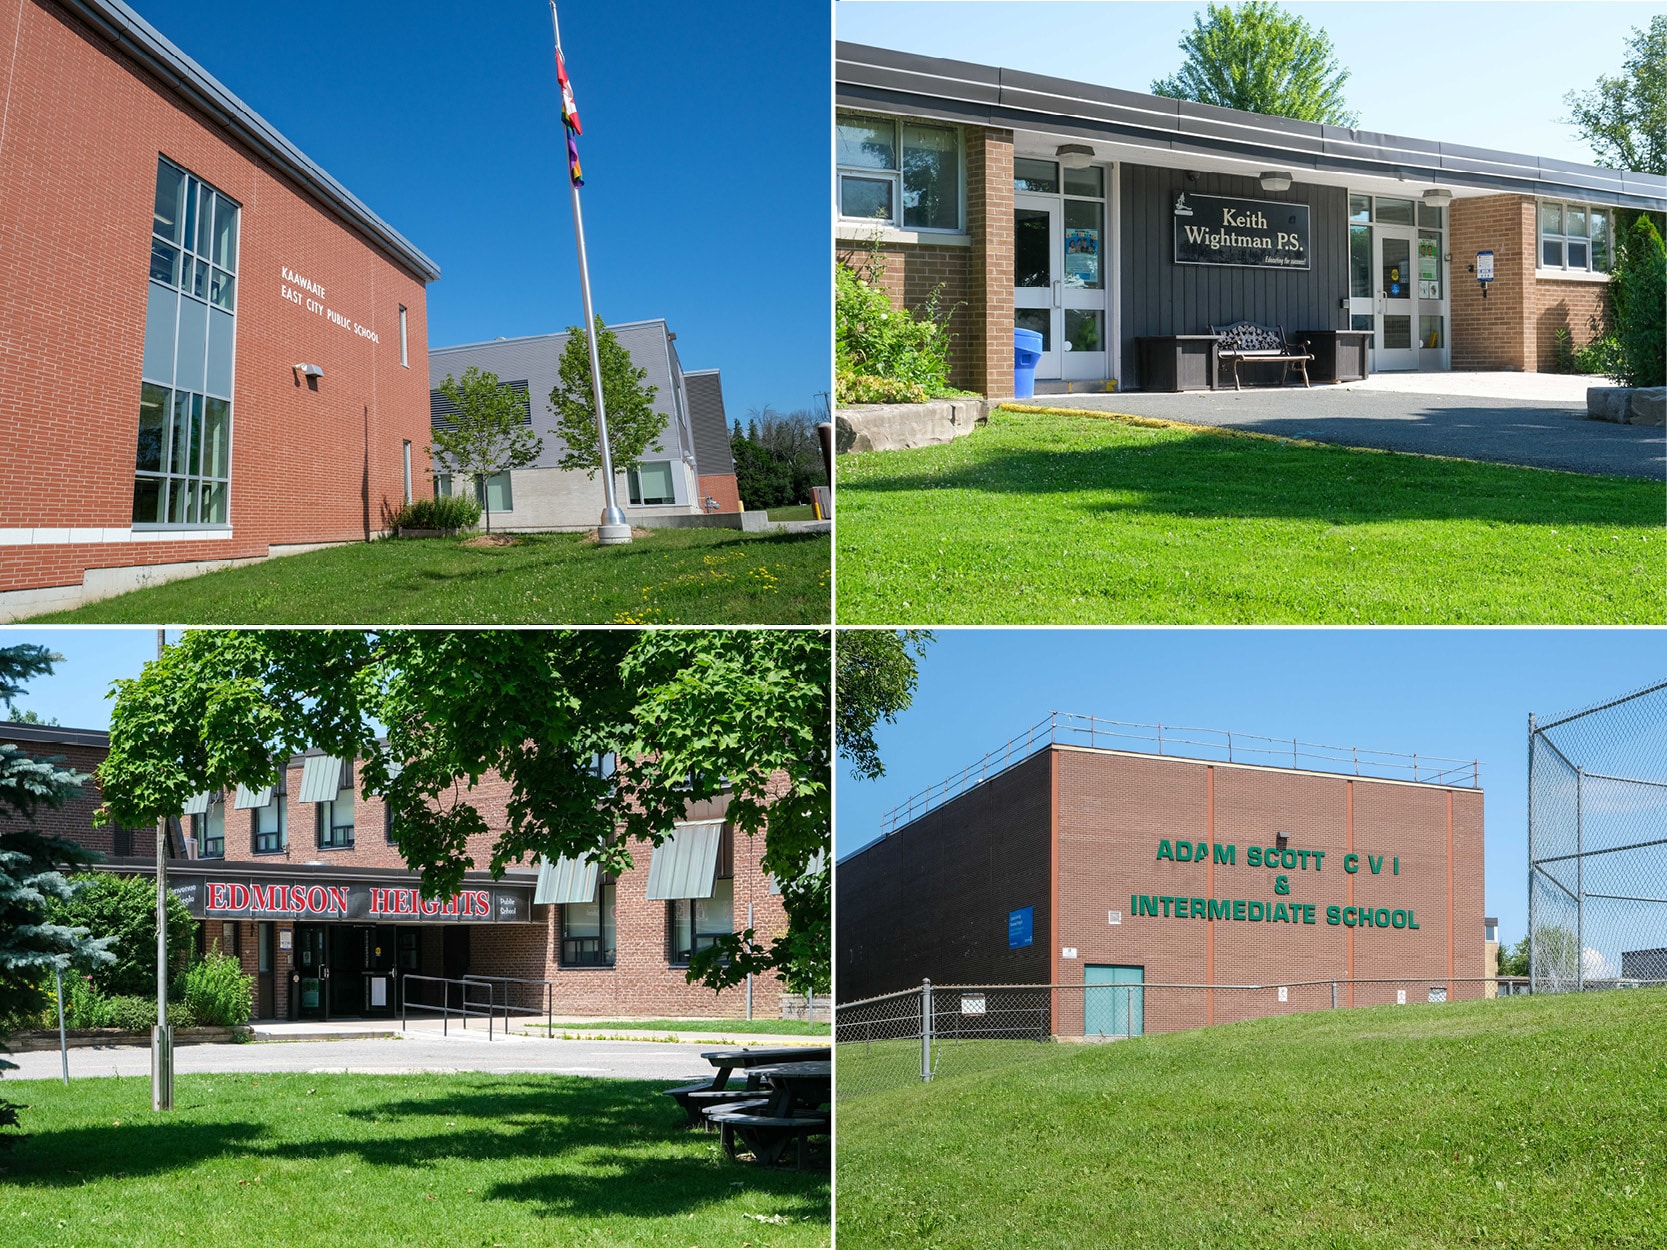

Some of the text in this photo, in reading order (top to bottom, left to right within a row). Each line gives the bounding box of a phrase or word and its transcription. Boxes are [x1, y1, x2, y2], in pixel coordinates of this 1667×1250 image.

[1222, 208, 1268, 229] Keith
[1184, 225, 1304, 252] Wightman P.S.
[281, 266, 325, 299] KAAWAATE
[281, 284, 380, 344] EAST CITY PUBLIC SCHOOL
[1156, 839, 1237, 865] ADAM
[1247, 845, 1326, 871] SCOTT
[1343, 853, 1360, 874] C
[1368, 855, 1384, 875] V
[206, 883, 490, 916] EDMISON HEIGHTS
[1274, 875, 1291, 895] &
[1130, 894, 1421, 930] INTERMEDIATE SCHOOL
